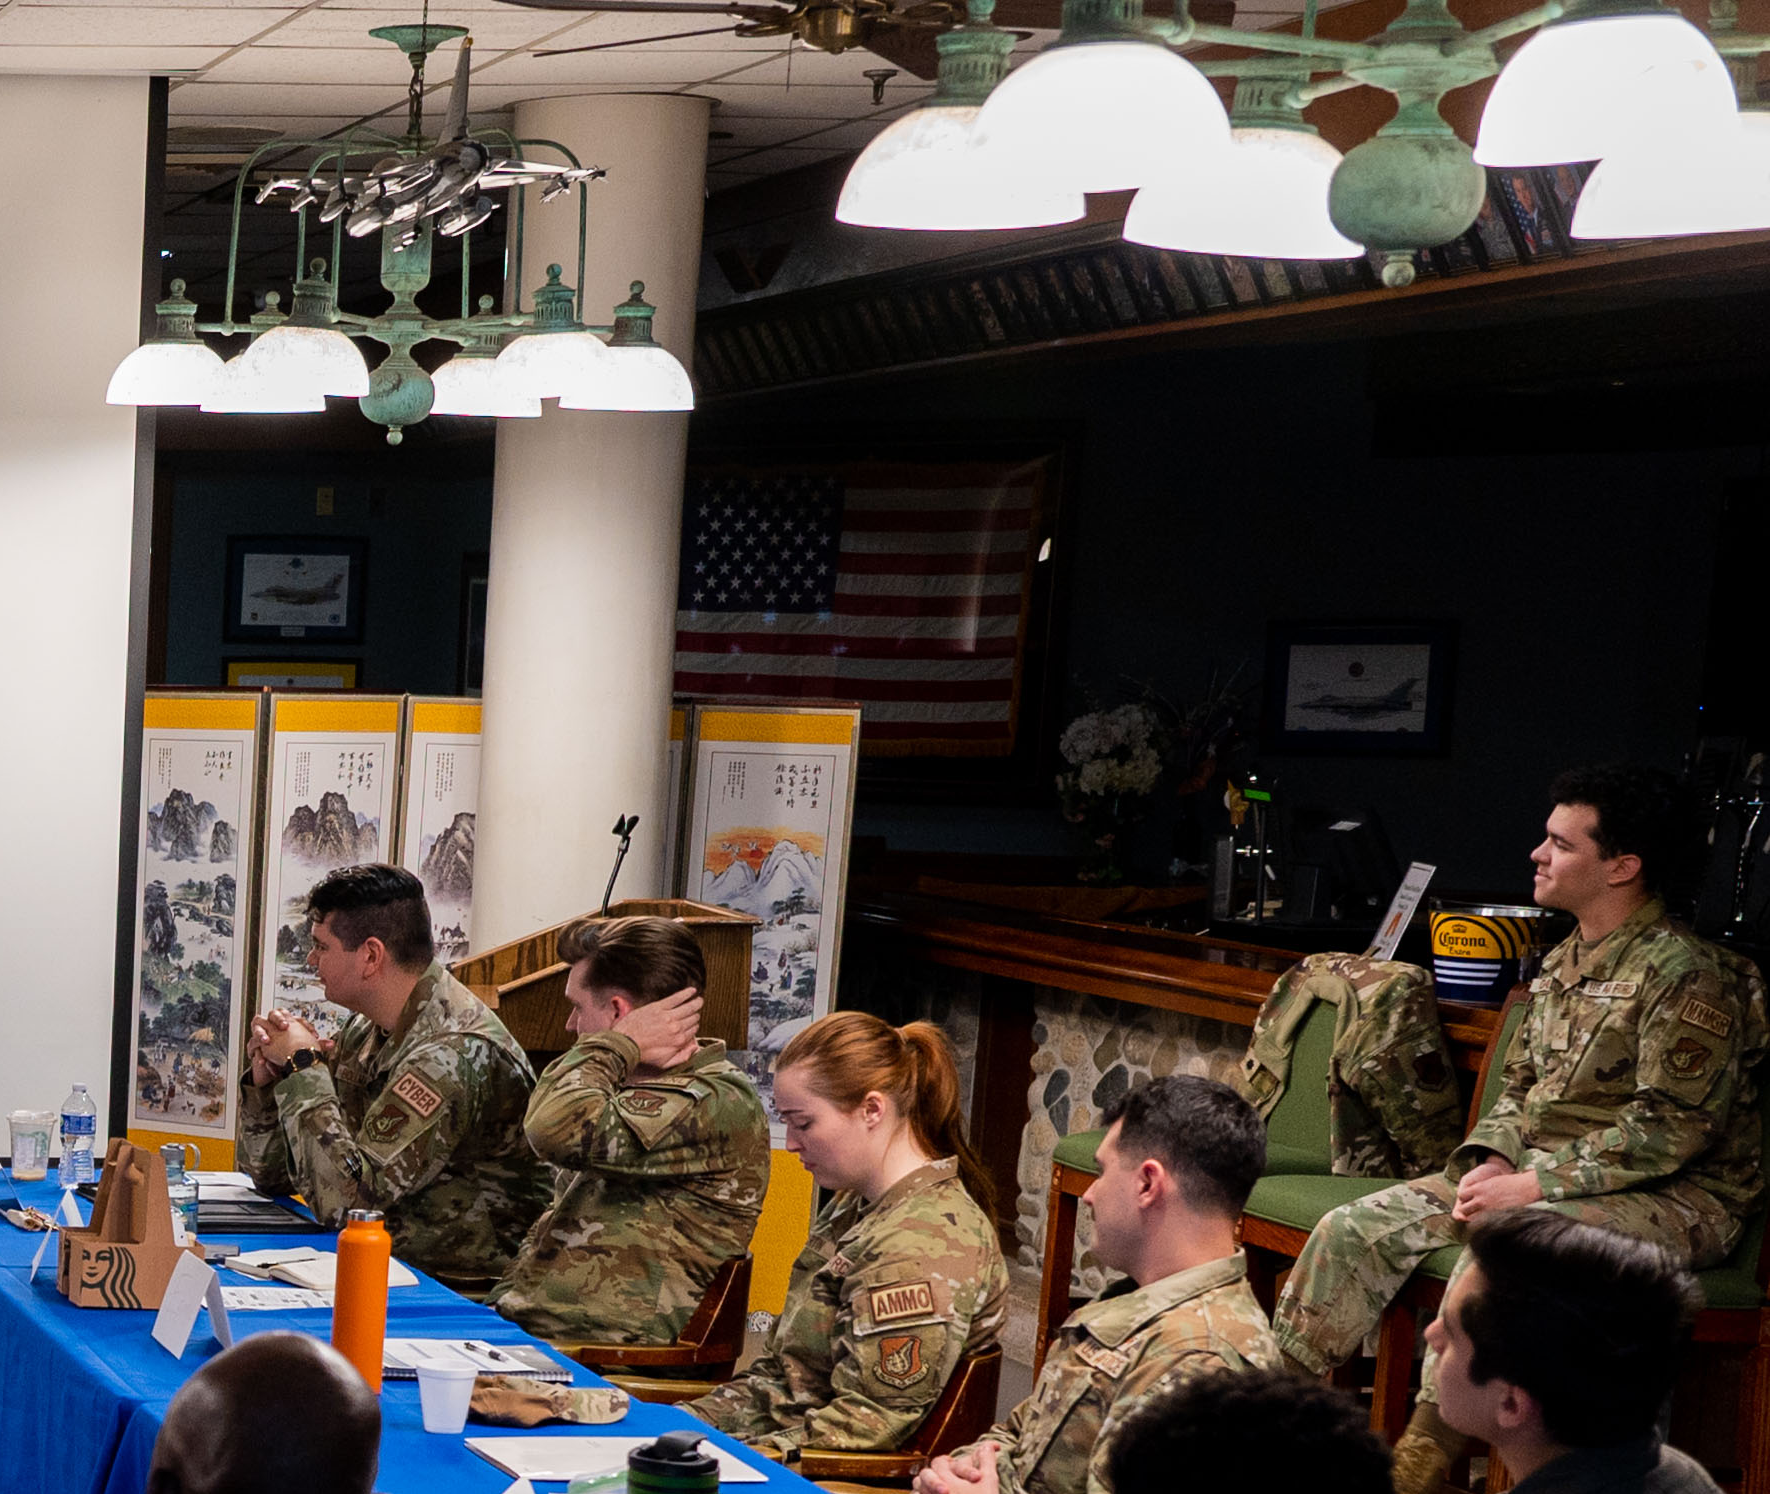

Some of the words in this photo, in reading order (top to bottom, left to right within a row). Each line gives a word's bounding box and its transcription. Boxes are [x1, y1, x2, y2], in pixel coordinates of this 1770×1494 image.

[1439, 931, 1486, 947] Corona
[1448, 947, 1471, 956] Extra
[397, 1077, 439, 1114] CYBER
[876, 1286, 931, 1317] AMMO
